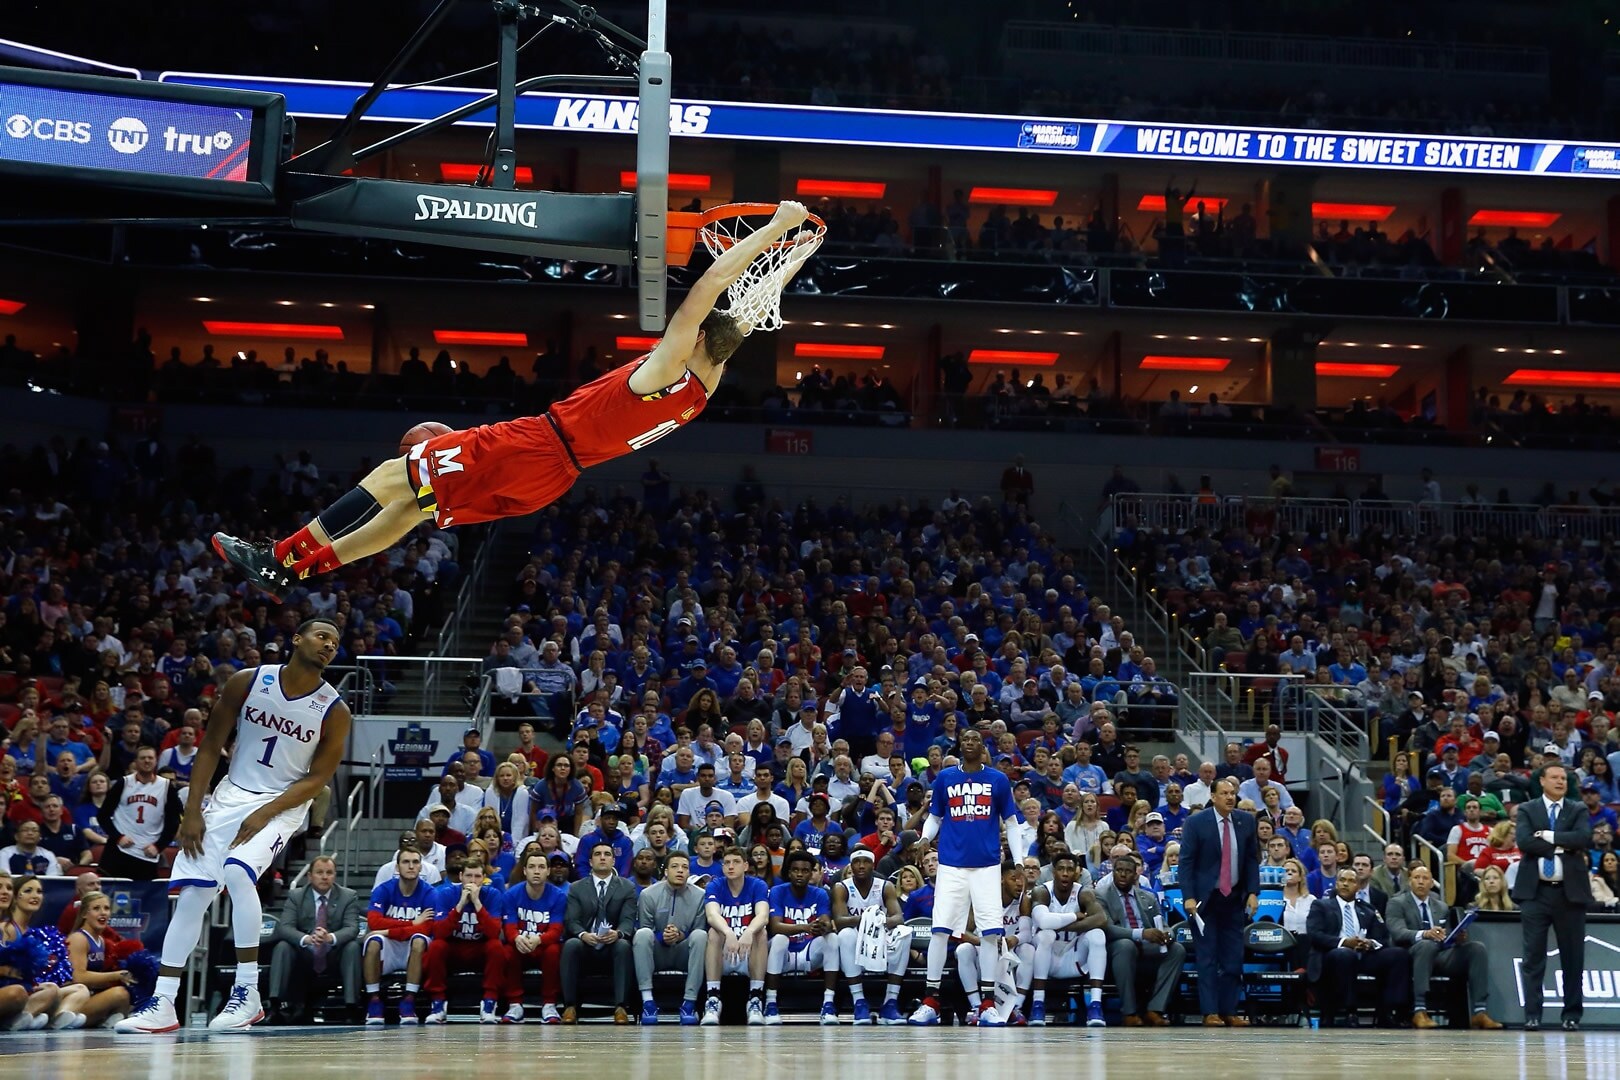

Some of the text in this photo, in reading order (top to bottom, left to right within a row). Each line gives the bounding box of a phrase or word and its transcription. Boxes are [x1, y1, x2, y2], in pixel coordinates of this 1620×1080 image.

[553, 98, 712, 134] KANAS
[33, 118, 91, 143] CBS
[1032, 124, 1063, 135] MARCH
[1035, 134, 1077, 145] MADNESS
[1137, 128, 1520, 169] WELCOME TO THE SWEET SIXTEEN
[415, 194, 538, 228] SPALDING
[785, 438, 808, 454] 115
[435, 445, 465, 477] M
[1335, 455, 1357, 472] 116
[245, 706, 316, 743] KANSAS
[257, 736, 279, 768] 1
[393, 743, 434, 753] REGIONAL
[947, 782, 993, 799] MADE
[964, 795, 976, 805] IN
[136, 806, 145, 824] 1
[950, 805, 991, 817] MARCH
[107, 917, 142, 928] EGIONAL
[518, 907, 551, 924] MADE
[462, 924, 474, 934] IN
[527, 921, 538, 932] IN
